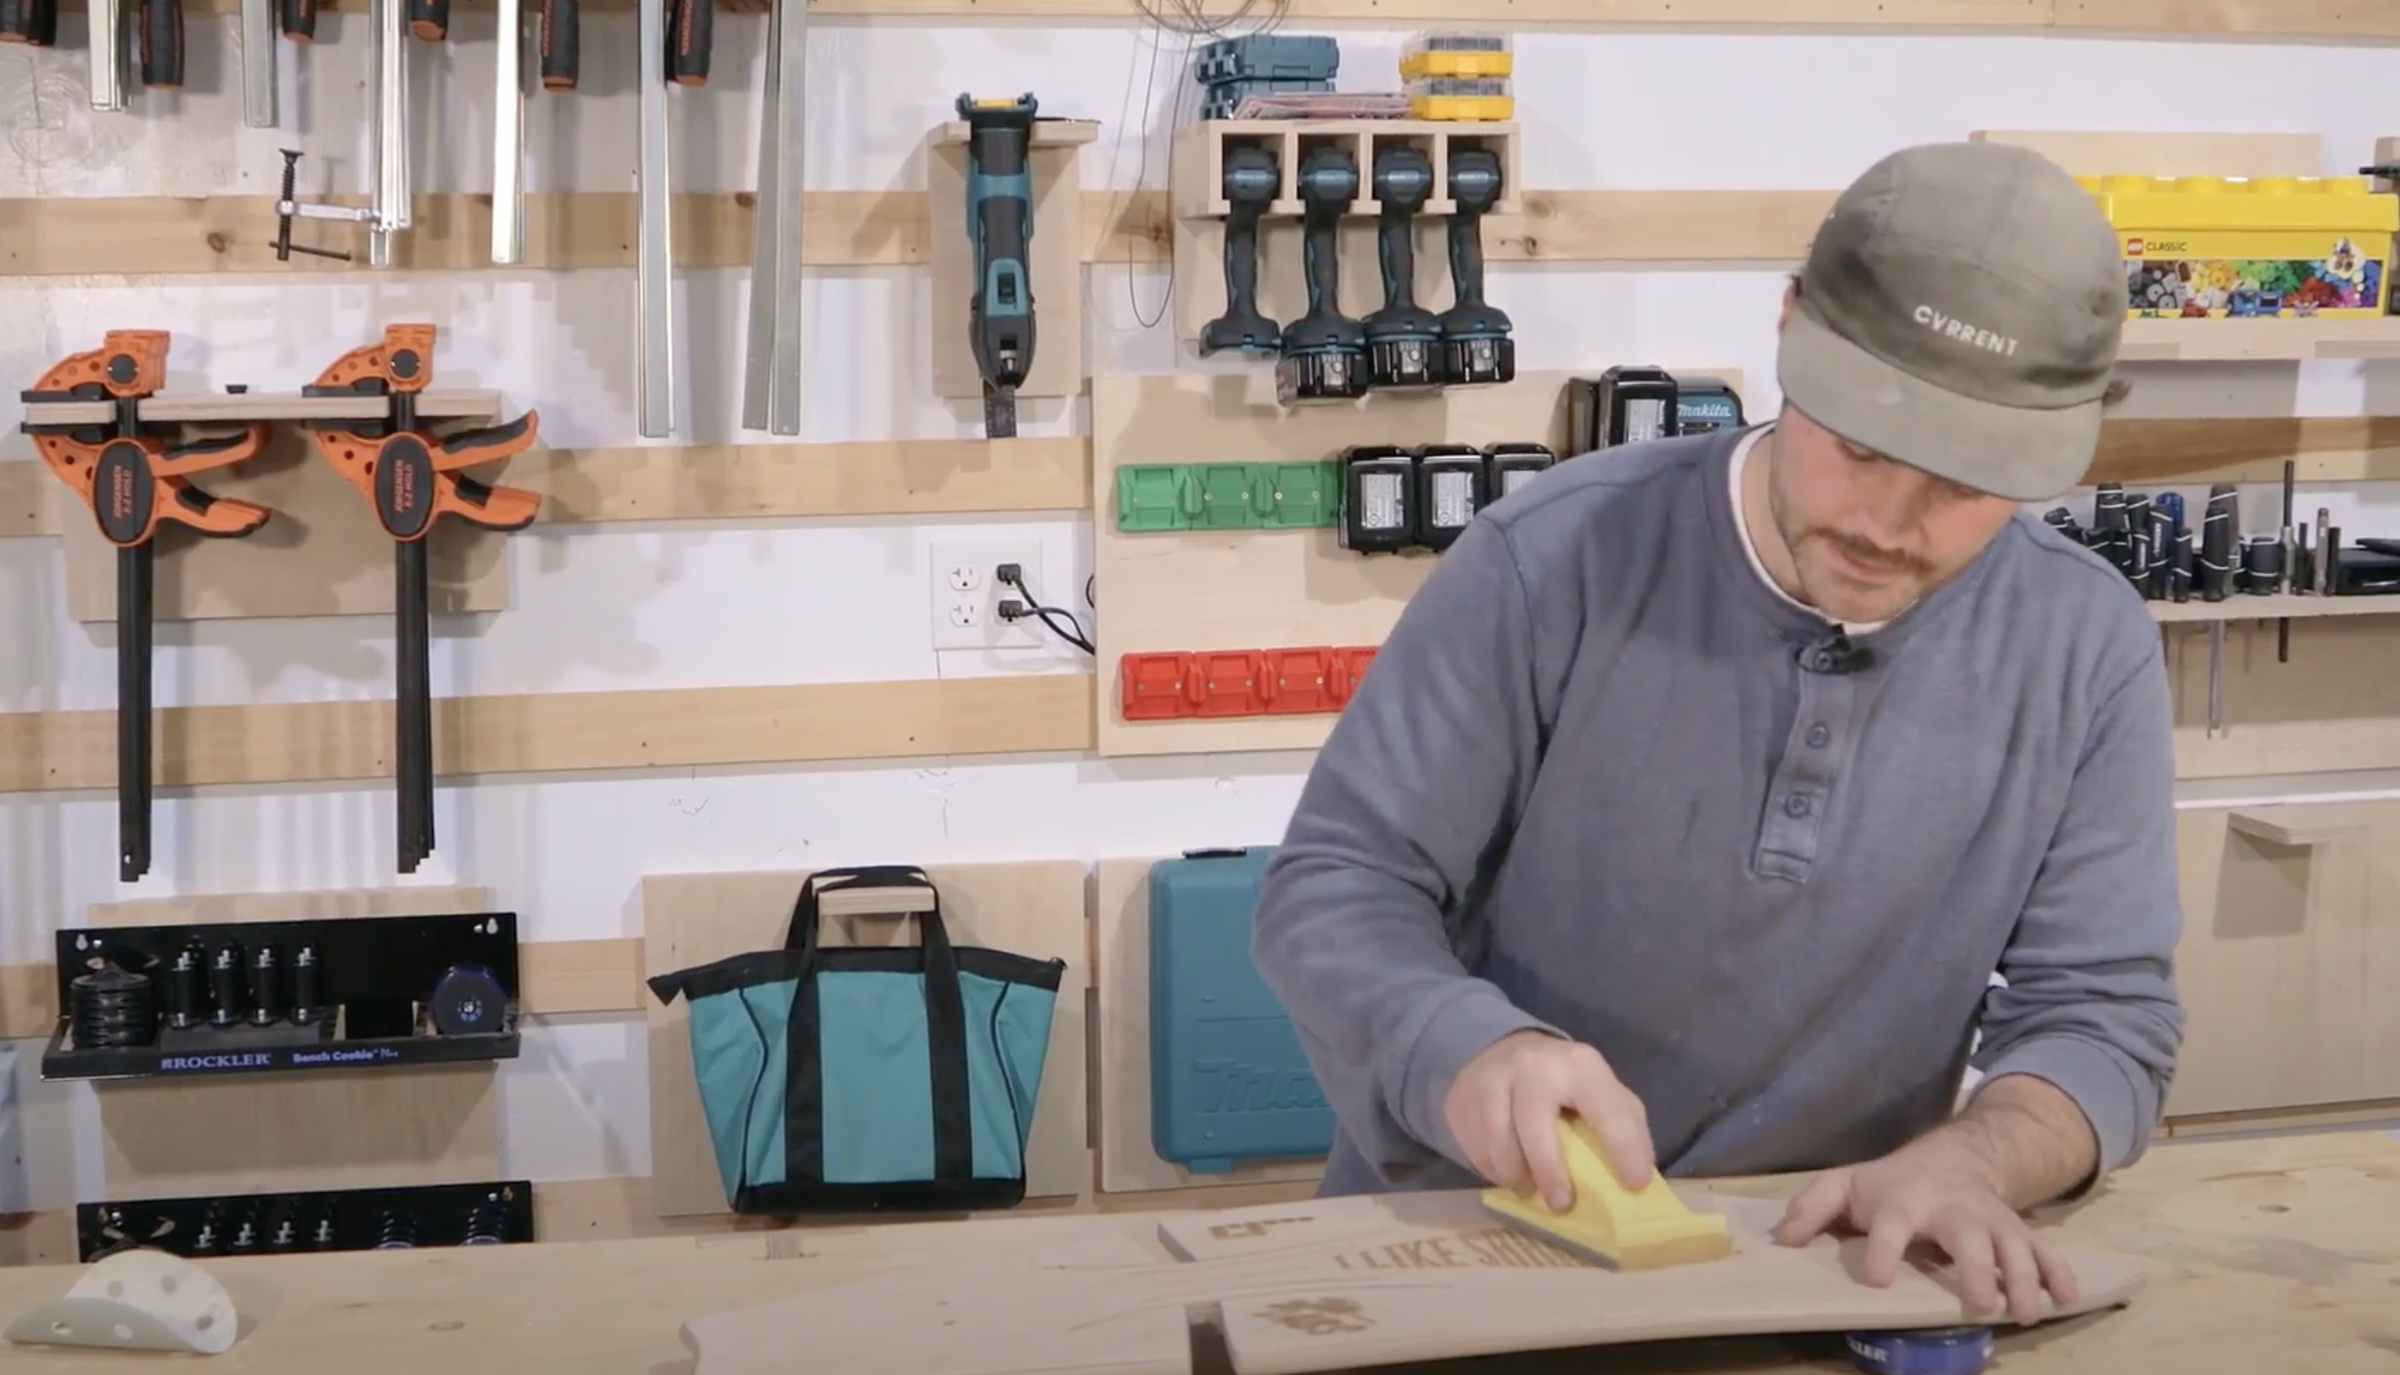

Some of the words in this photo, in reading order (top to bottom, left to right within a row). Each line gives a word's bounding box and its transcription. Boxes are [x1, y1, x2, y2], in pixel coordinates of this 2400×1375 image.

[2146, 241, 2187, 252] CLASSIC
[1914, 305, 2018, 357] CVRRENT
[112, 465, 123, 519] JORGENSEN
[122, 470, 132, 497] HOLD
[393, 459, 405, 513] JORGENSEN
[404, 464, 413, 491] HOLD
[174, 1053, 270, 1070] ROCKLER
[293, 1052, 330, 1063] Bench
[1359, 1236, 1469, 1269] LIKE
